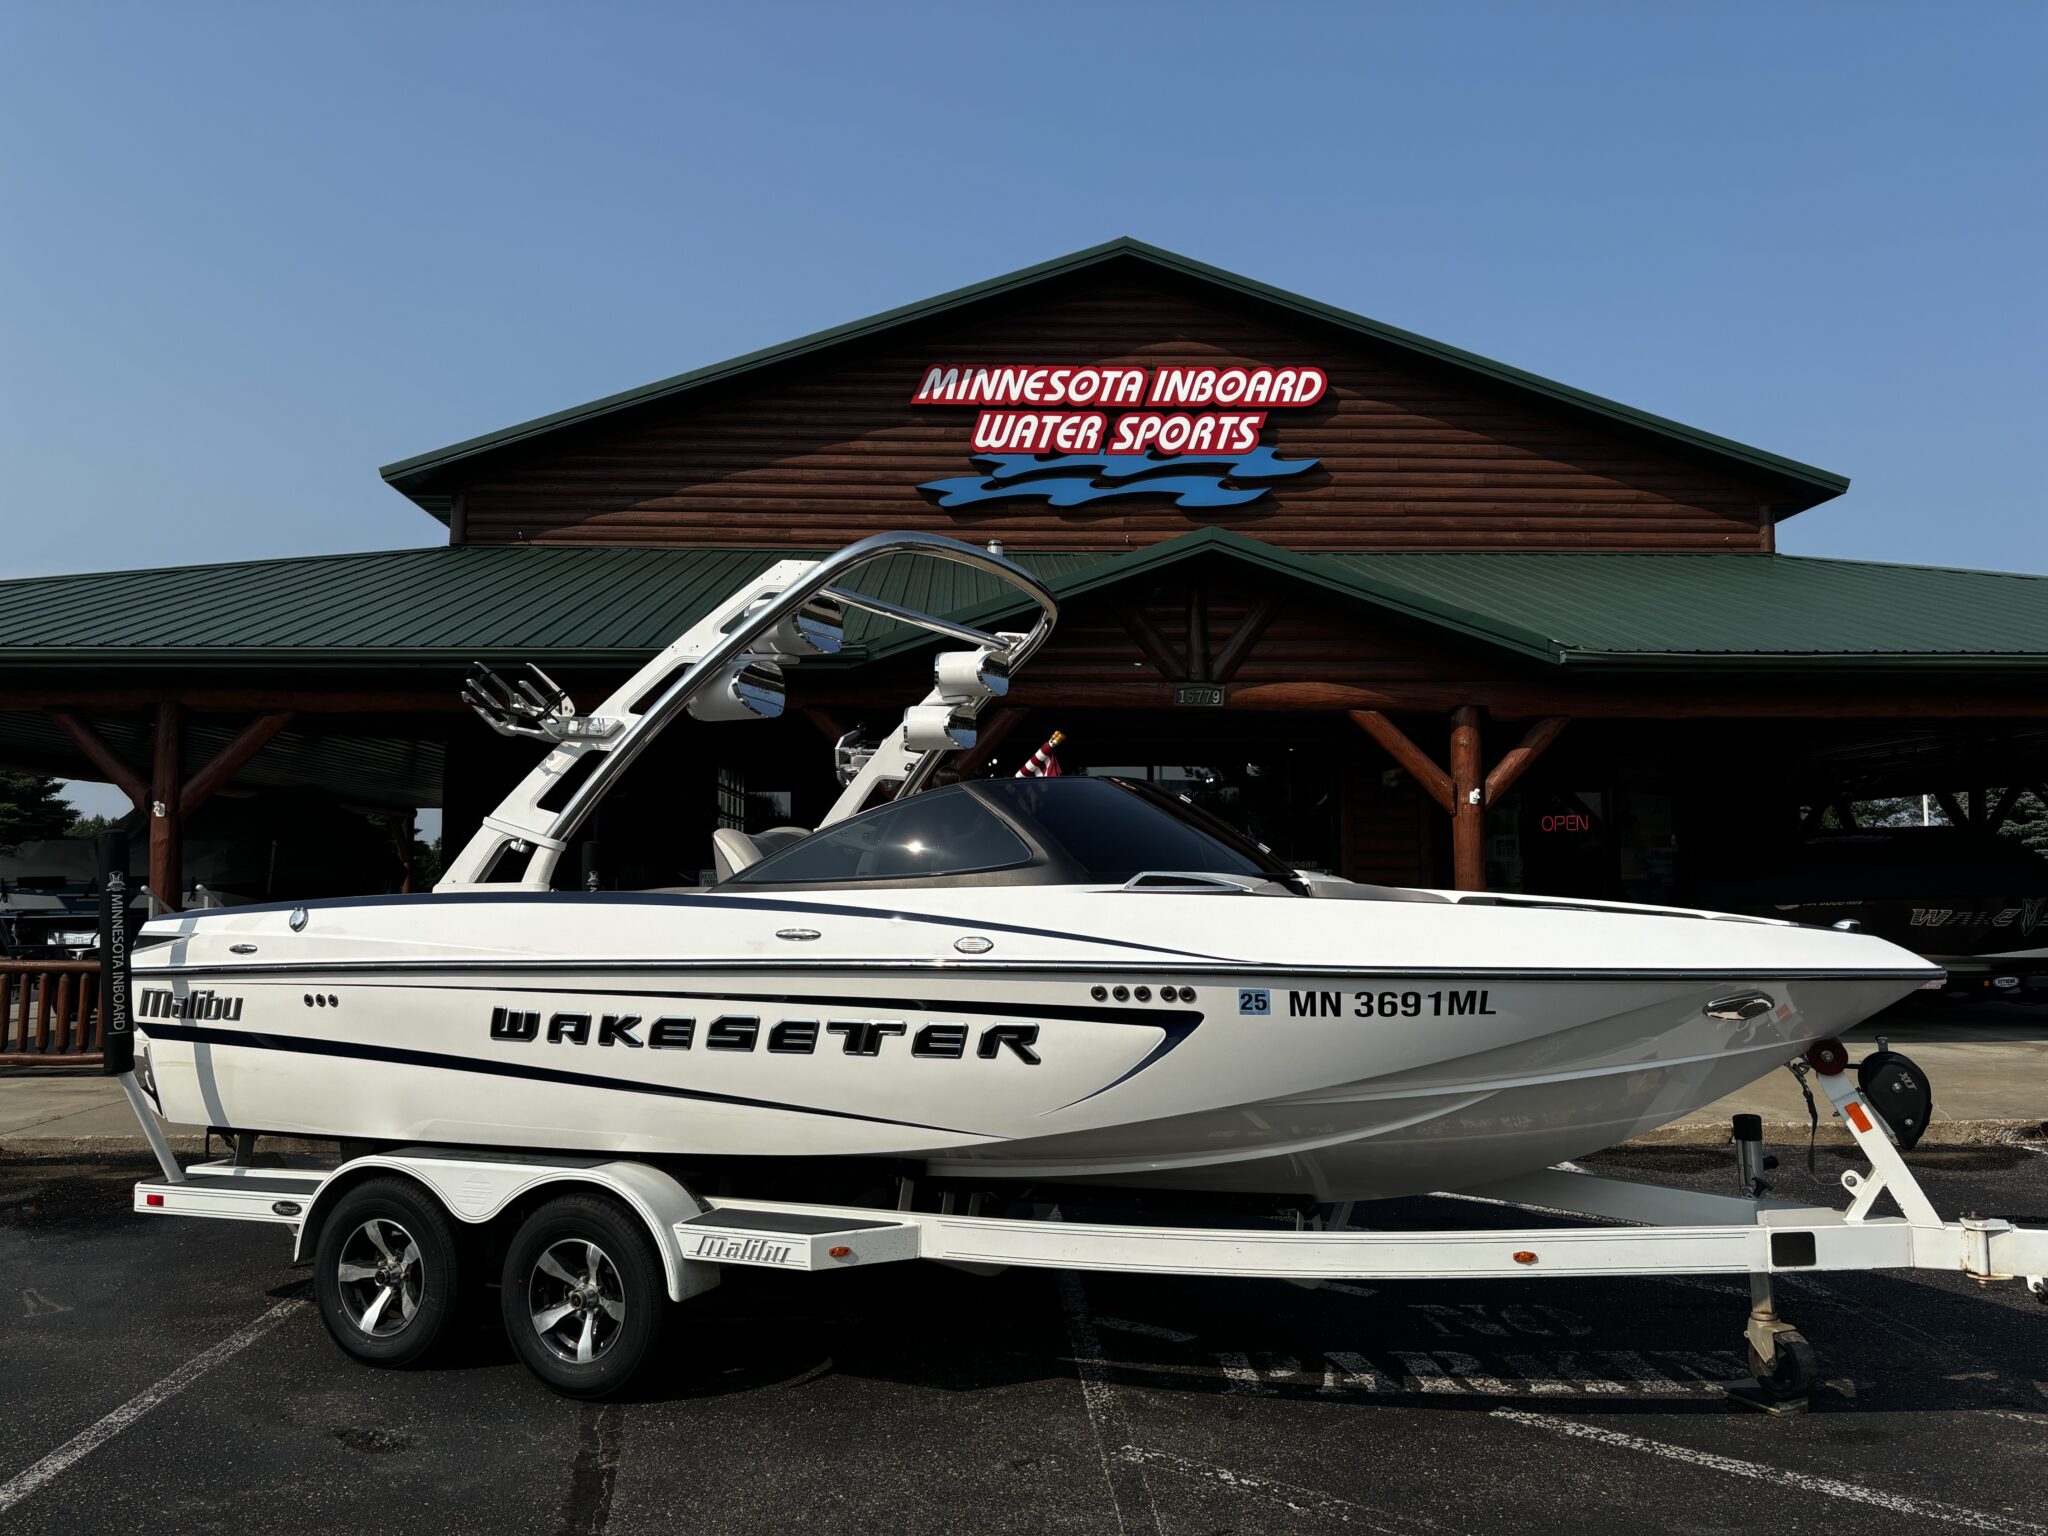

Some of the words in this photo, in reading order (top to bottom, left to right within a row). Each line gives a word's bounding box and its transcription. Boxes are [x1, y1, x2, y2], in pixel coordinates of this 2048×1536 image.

[918, 367, 1142, 402] MINNESOTA
[1151, 369, 1323, 402] INBOARD
[974, 413, 1101, 449] WATER
[1112, 415, 1261, 450] SPORTS
[1541, 815, 1590, 832] OPEN
[111, 894, 125, 970] MINNESOTA
[112, 972, 126, 1031] INBOARD
[139, 988, 243, 1021] Malibu
[1240, 993, 1268, 1011] 25
[1289, 990, 1342, 1018] MN
[490, 1005, 1042, 1065] WAKESETTER
[696, 1235, 791, 1263] Malibu
[1216, 1350, 1858, 1398] PARKIN
